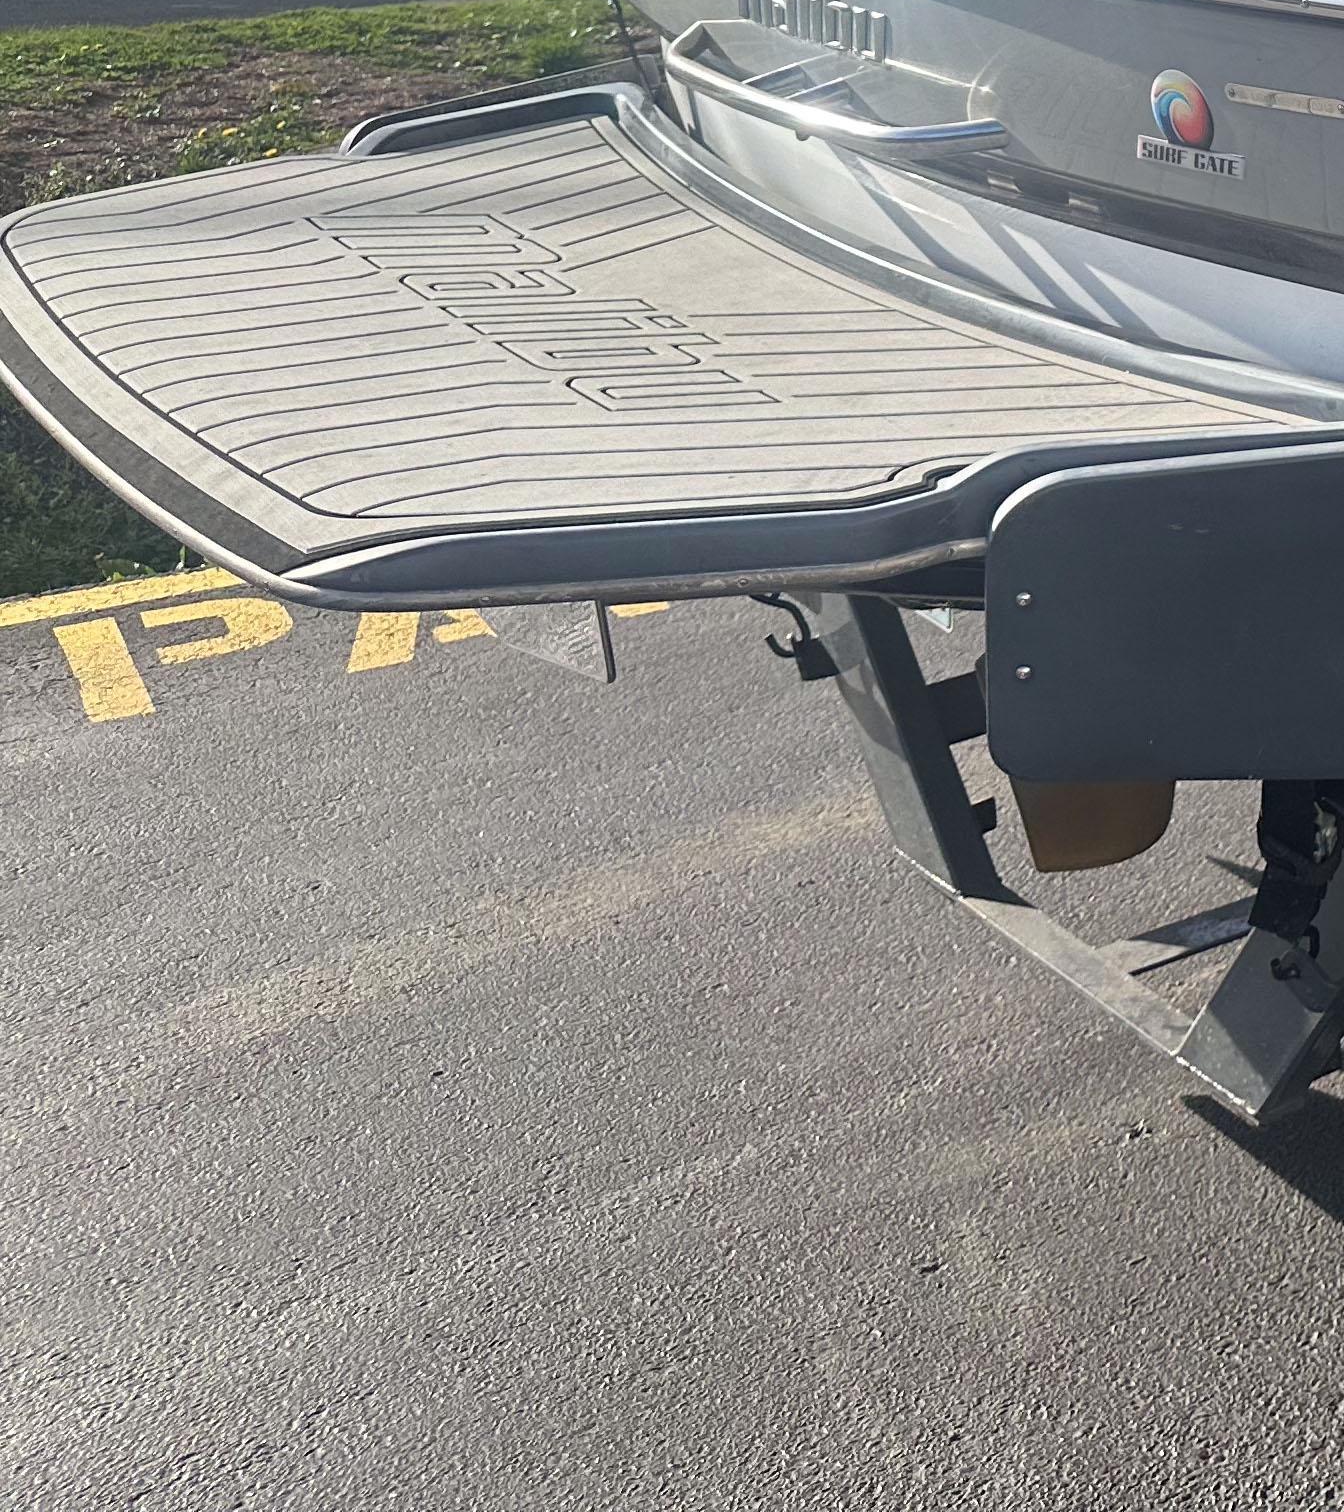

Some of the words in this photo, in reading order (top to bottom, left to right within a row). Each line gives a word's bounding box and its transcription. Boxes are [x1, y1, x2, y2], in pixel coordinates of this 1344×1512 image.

[1142, 141, 1190, 165] SURF
[1194, 152, 1239, 176] GATE
[304, 213, 782, 412] malibu
